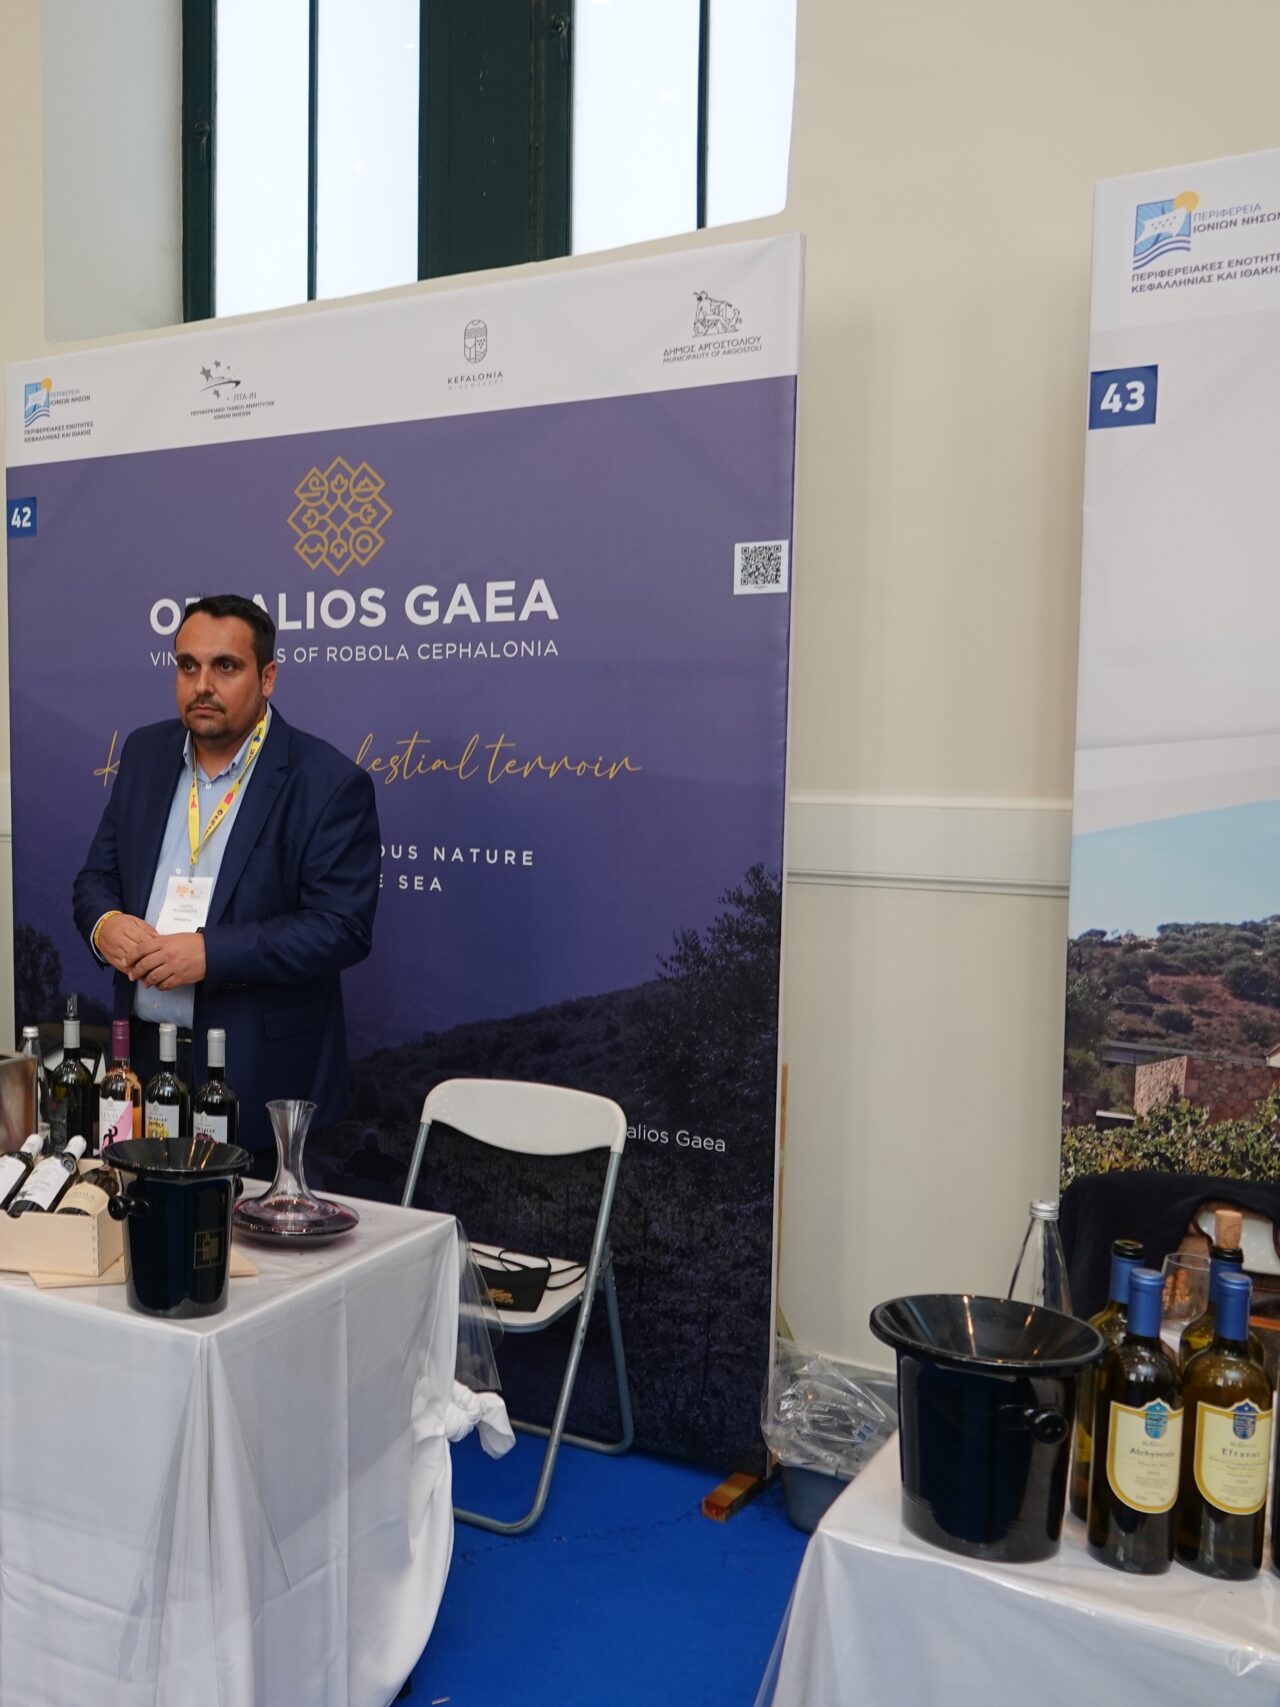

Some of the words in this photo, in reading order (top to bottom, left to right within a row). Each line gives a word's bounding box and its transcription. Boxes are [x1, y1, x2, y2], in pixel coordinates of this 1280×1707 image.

[1193, 202, 1262, 222] ΠΕΡΙΦΕΡΕΙΑ
[1193, 220, 1238, 234] ΙΟΝΙΩΝ
[1131, 261, 1225, 283] ΠΕΡΙΦΕΡΕΙΑΚΕΣ
[1131, 274, 1214, 294] ΚΕΦΑΛΛΗΝΙΑΣ
[1216, 270, 1237, 283] ΚΑΙ
[1240, 265, 1280, 279] ΙΘΑΚΗ
[663, 344, 696, 357] ΔΗΜΟΣ
[698, 335, 762, 352] ΑΡΓΟΣΤΟΛΙΟΥ
[663, 352, 710, 364] MUNICIPALITY
[711, 350, 721, 358] OF
[722, 344, 762, 356] ARGOSTOLI
[447, 370, 504, 384] KEFALONIA
[1100, 380, 1145, 414] 43
[11, 506, 32, 528] 42
[150, 587, 387, 636] OLIOS
[404, 578, 560, 626] GAEA
[293, 647, 319, 664] OF
[326, 644, 410, 663] ROBOLA
[417, 639, 559, 661] CEPHALONIA
[354, 730, 480, 785] lestial
[484, 732, 642, 785] terroir
[433, 846, 534, 866] NATURE
[398, 874, 442, 892] SEA
[626, 1123, 669, 1144] alios
[675, 1129, 726, 1153] Gaea
